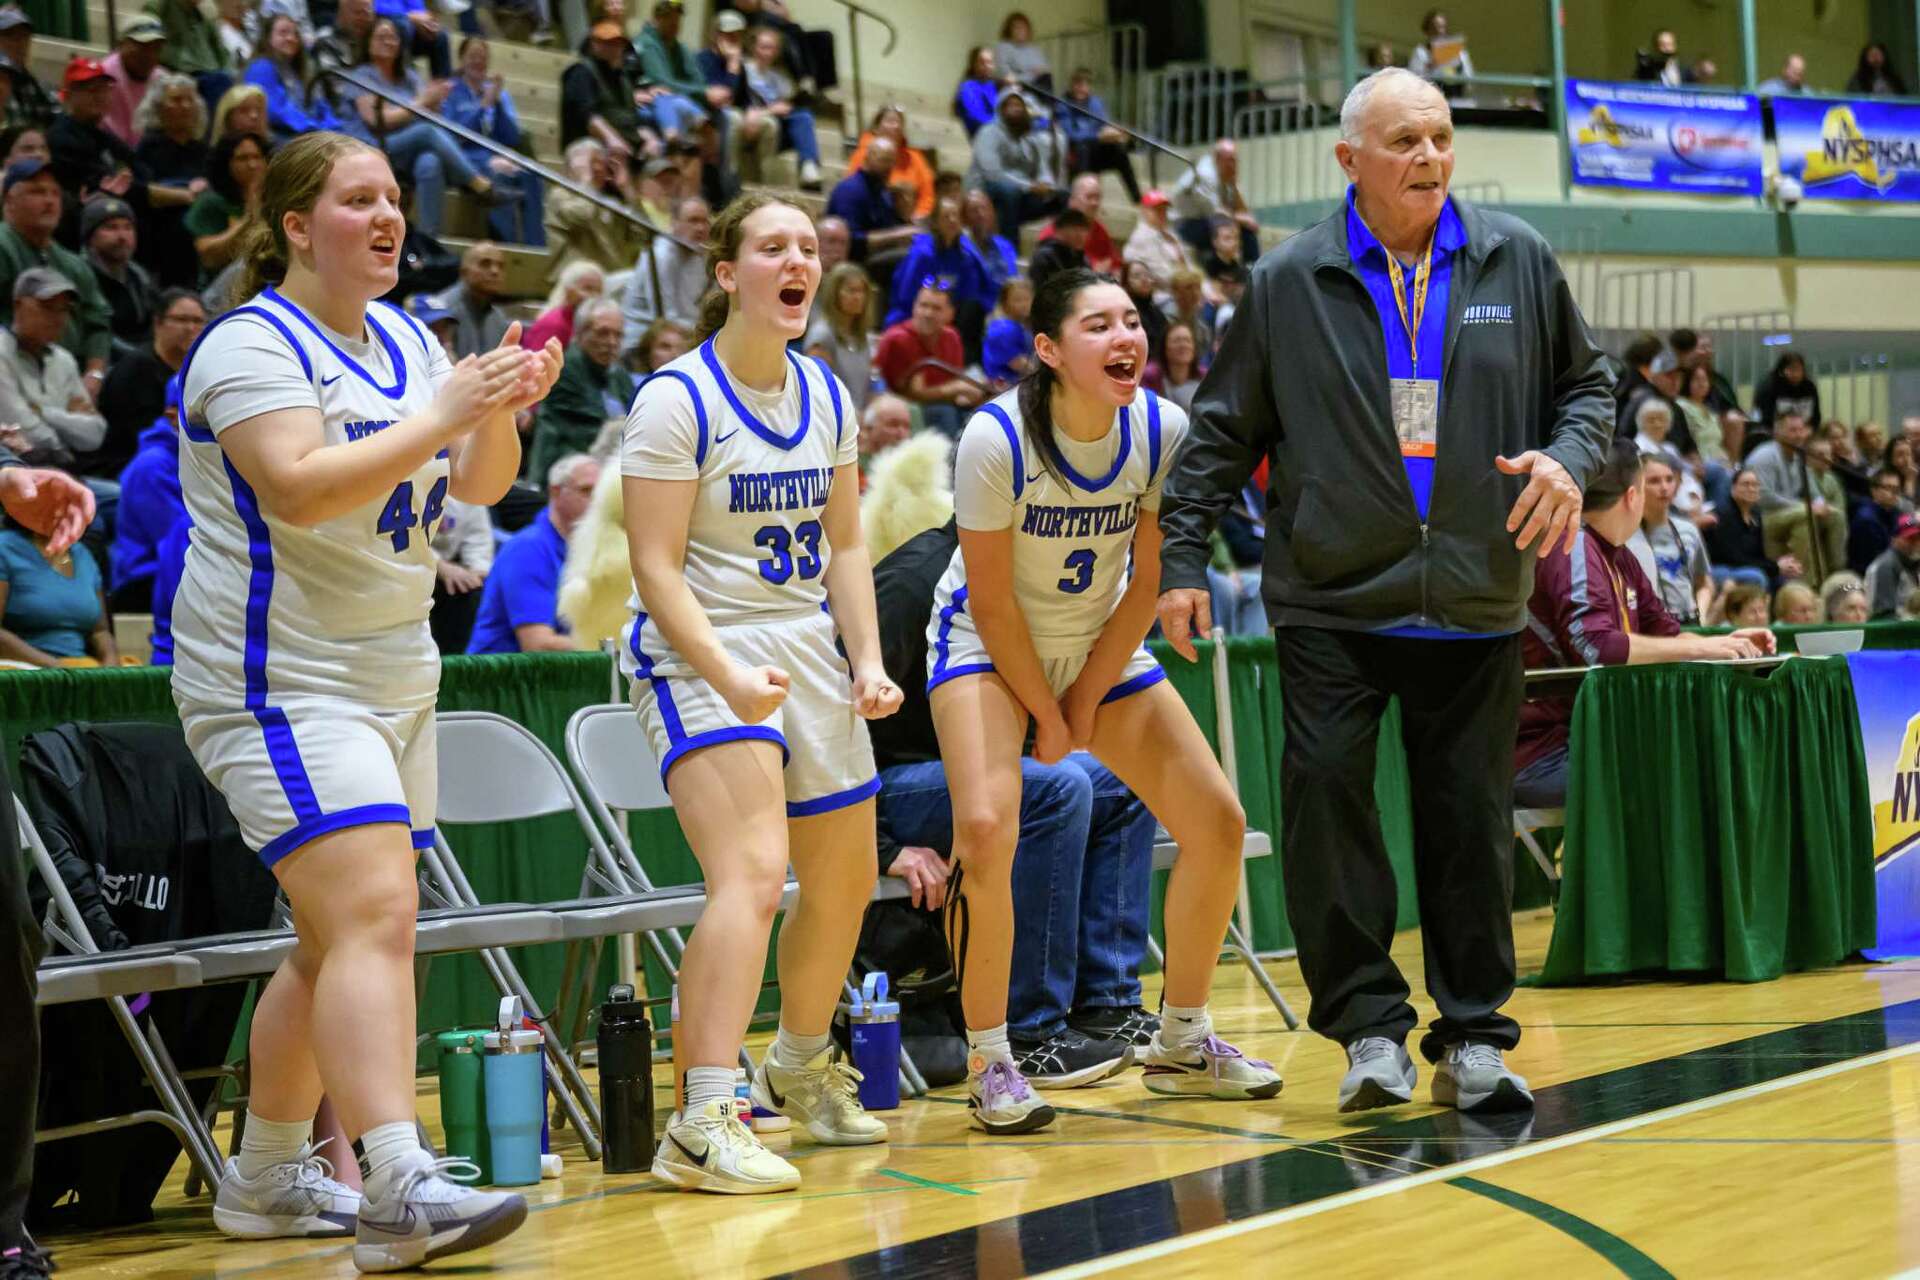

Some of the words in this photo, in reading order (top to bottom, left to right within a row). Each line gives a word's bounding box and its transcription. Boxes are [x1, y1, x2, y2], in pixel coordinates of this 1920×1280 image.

[376, 475, 448, 553] 44
[753, 519, 823, 586] 33
[1056, 548, 1098, 594] 3
